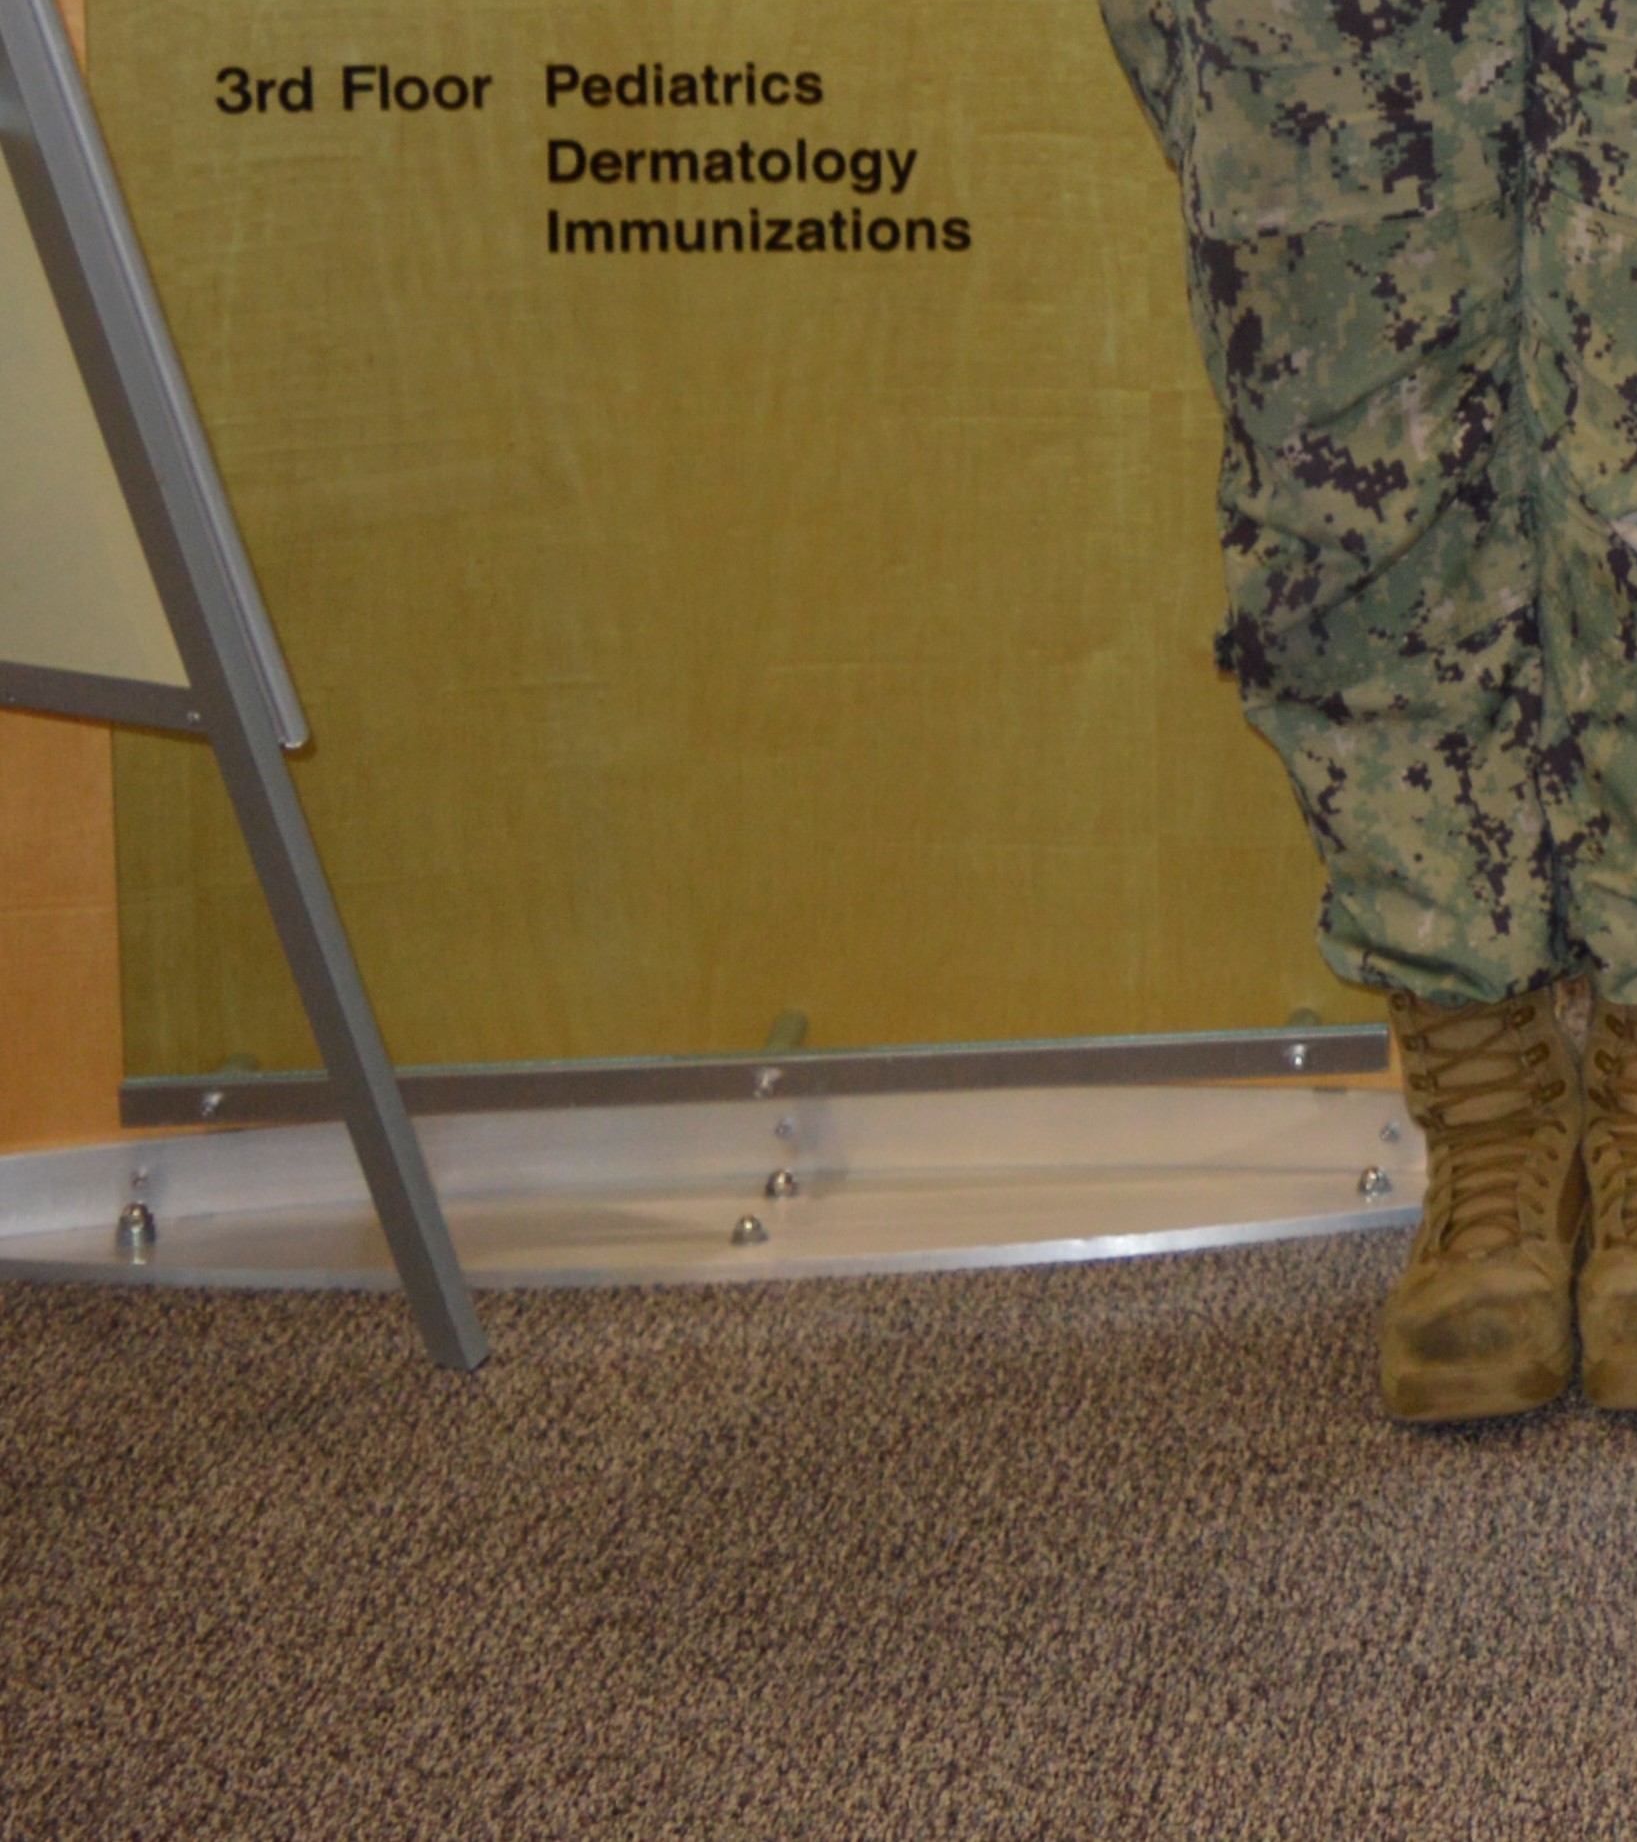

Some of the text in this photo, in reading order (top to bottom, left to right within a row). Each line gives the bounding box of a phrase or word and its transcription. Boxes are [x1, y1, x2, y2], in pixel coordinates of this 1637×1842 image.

[217, 63, 822, 114] 3rd Floor Pediatrics
[548, 139, 916, 194] Dermatology
[548, 208, 971, 252] Immunizations
